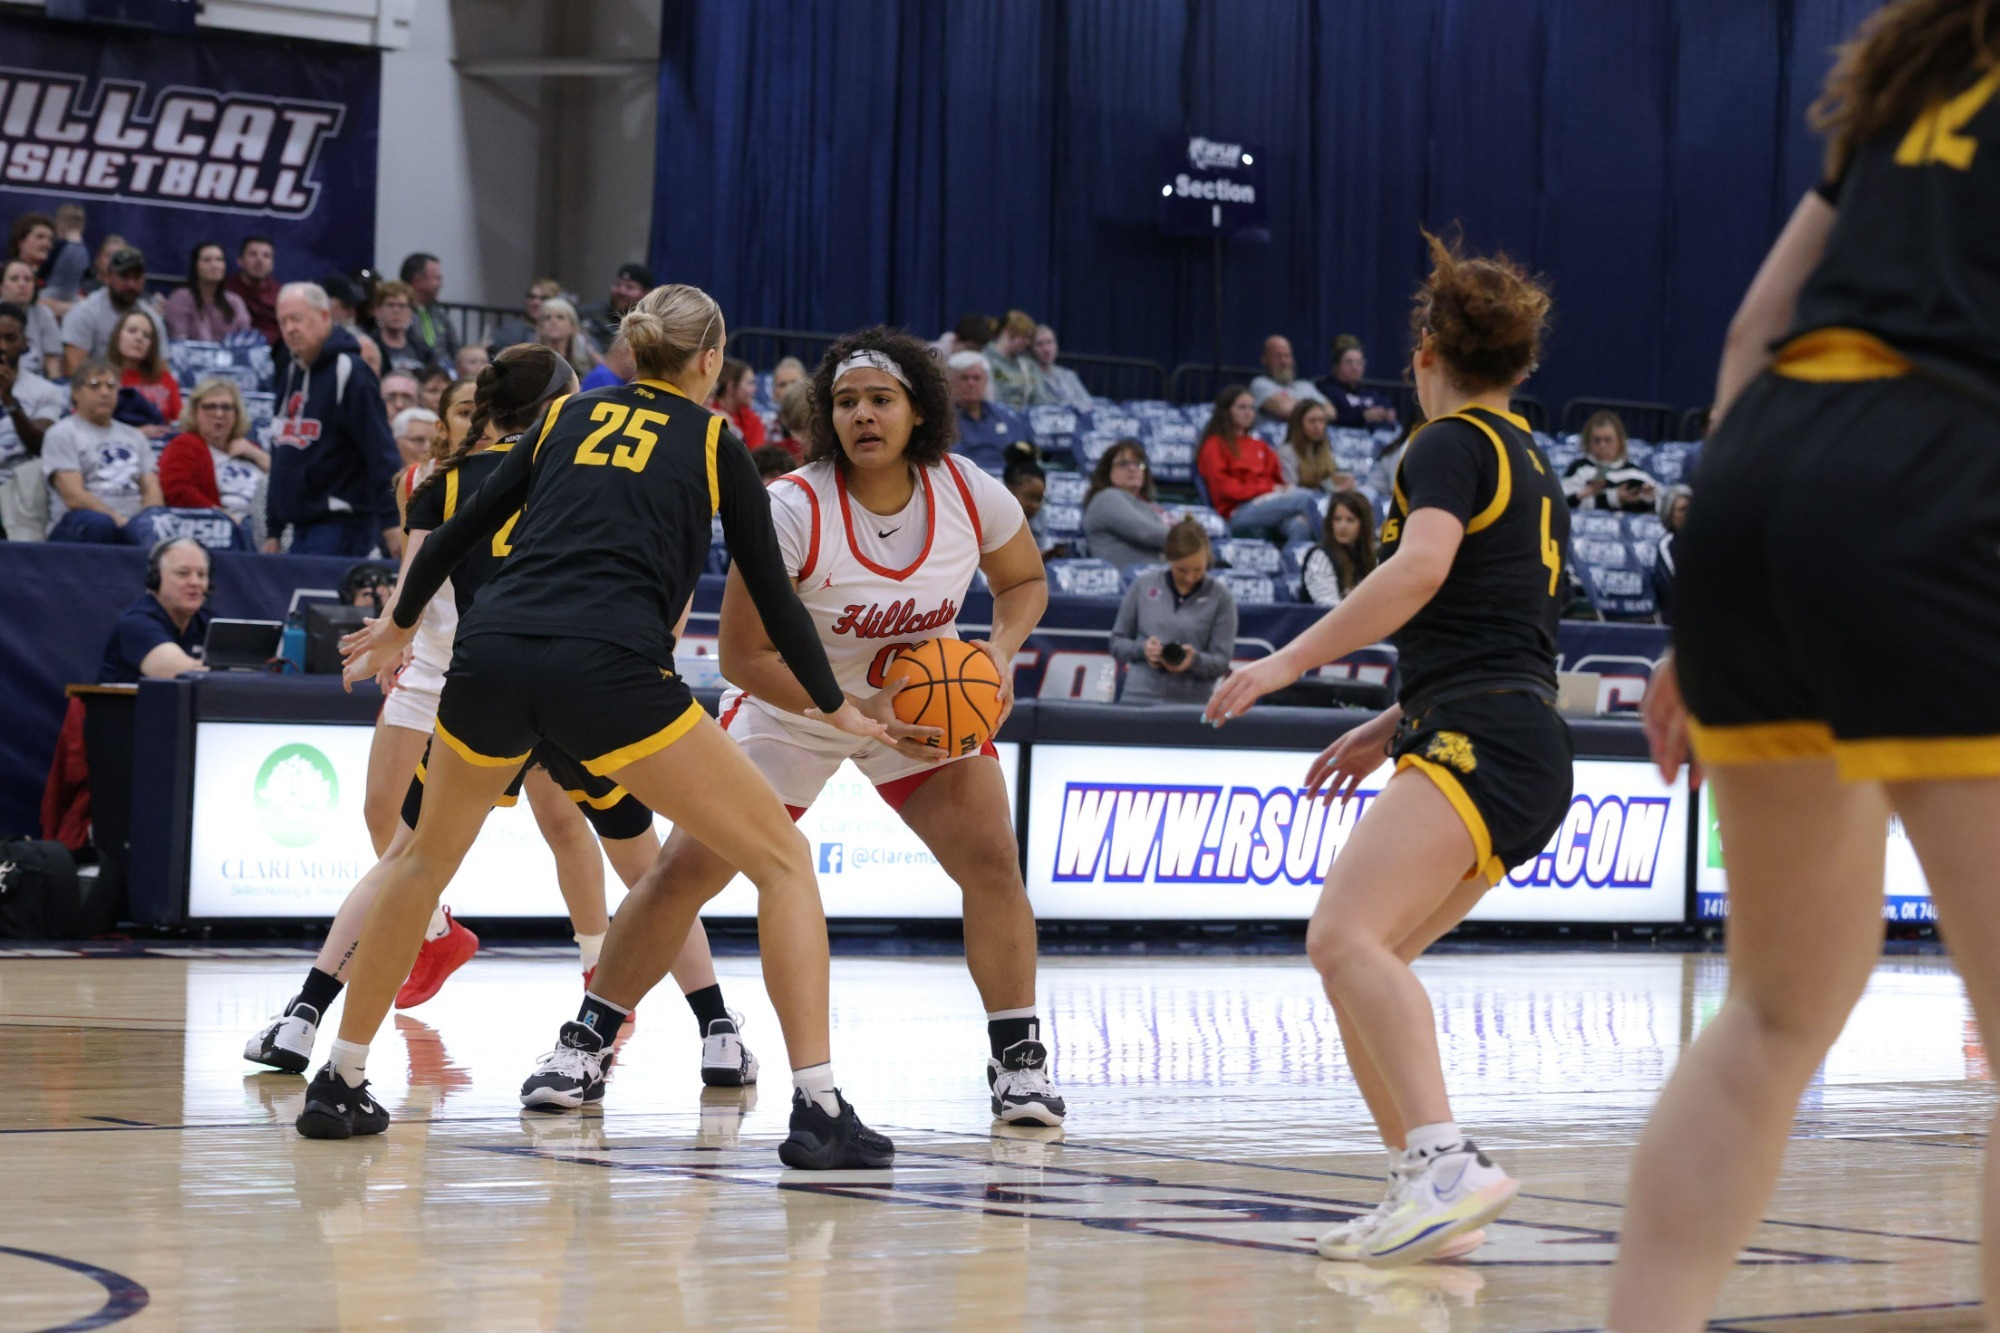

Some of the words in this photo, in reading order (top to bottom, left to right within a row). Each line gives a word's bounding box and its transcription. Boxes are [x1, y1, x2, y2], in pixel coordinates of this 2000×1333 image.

[0, 78, 333, 167] ILLCAT
[0, 140, 308, 208] SKETBALL
[1175, 173, 1256, 203] Section
[573, 401, 671, 473] 25
[1540, 496, 1561, 597] 4
[832, 598, 957, 639] Hillcats
